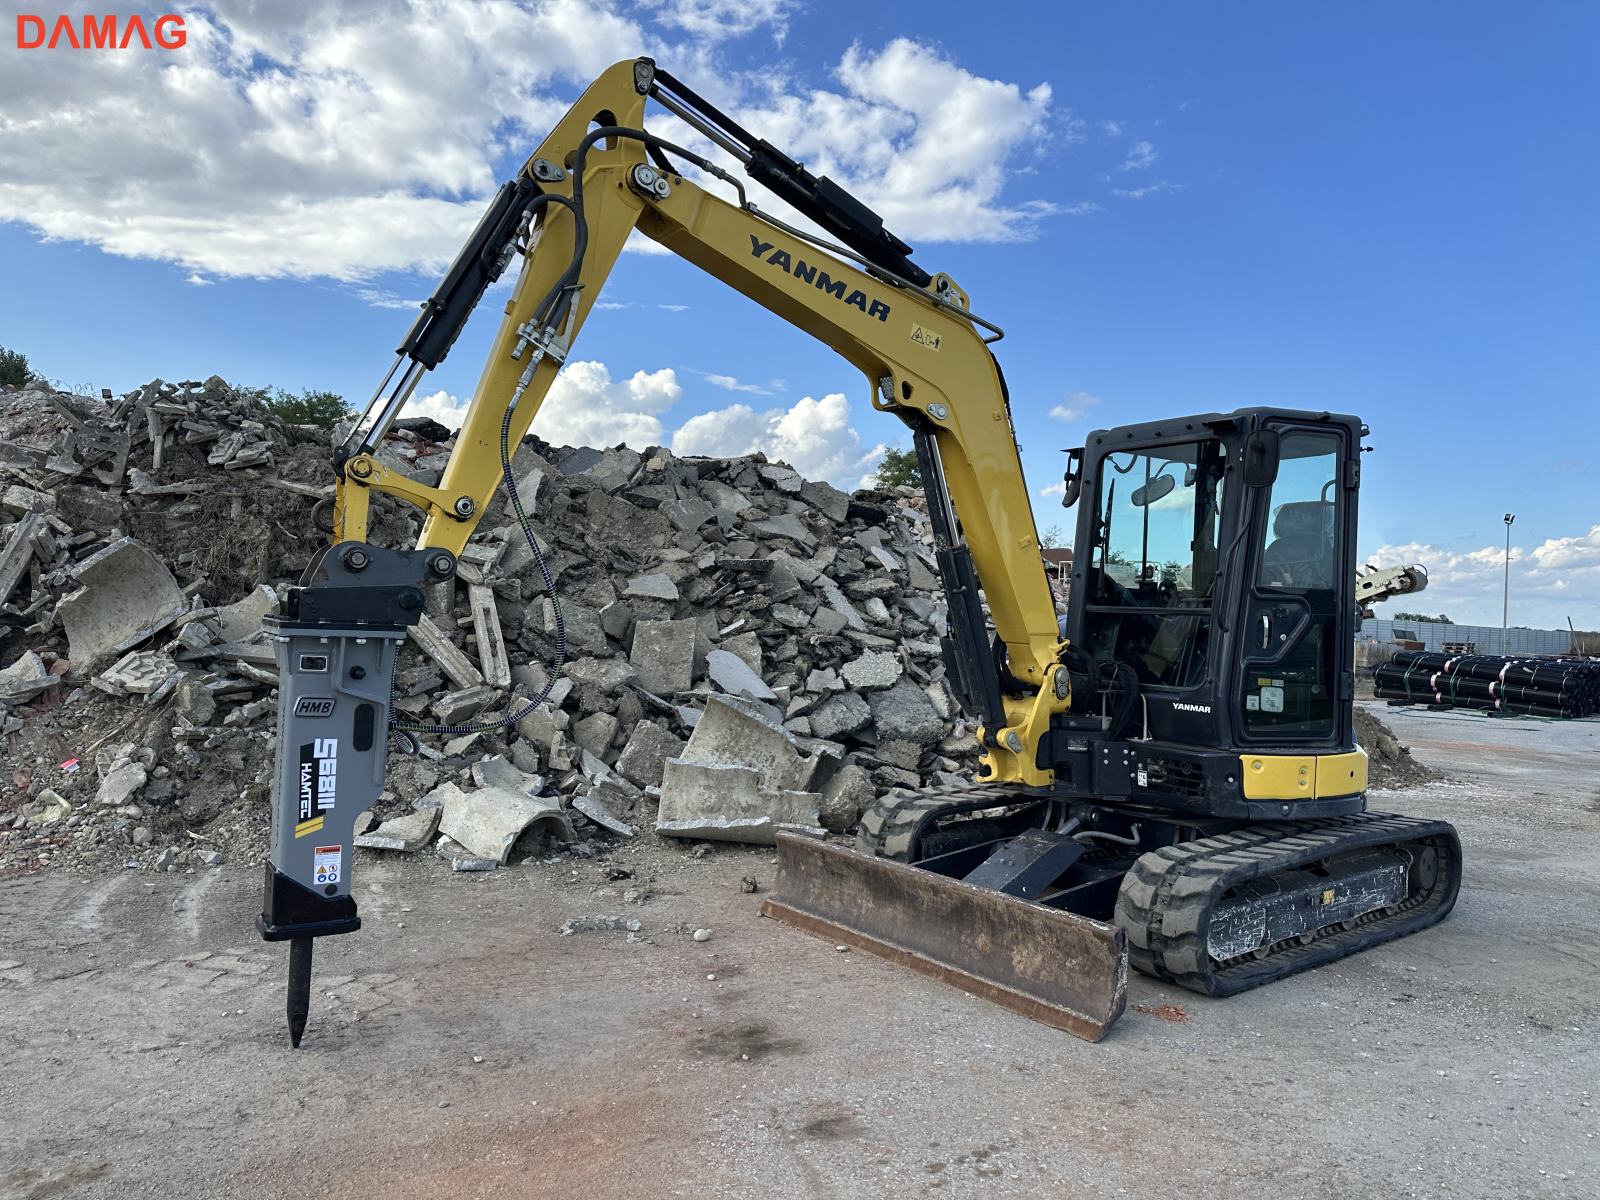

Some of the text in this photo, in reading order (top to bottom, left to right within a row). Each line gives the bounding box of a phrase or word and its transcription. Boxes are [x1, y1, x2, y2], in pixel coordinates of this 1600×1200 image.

[750, 234, 891, 322] YANMAR
[299, 701, 331, 713] HMB
[1172, 702, 1211, 713] YANMAR
